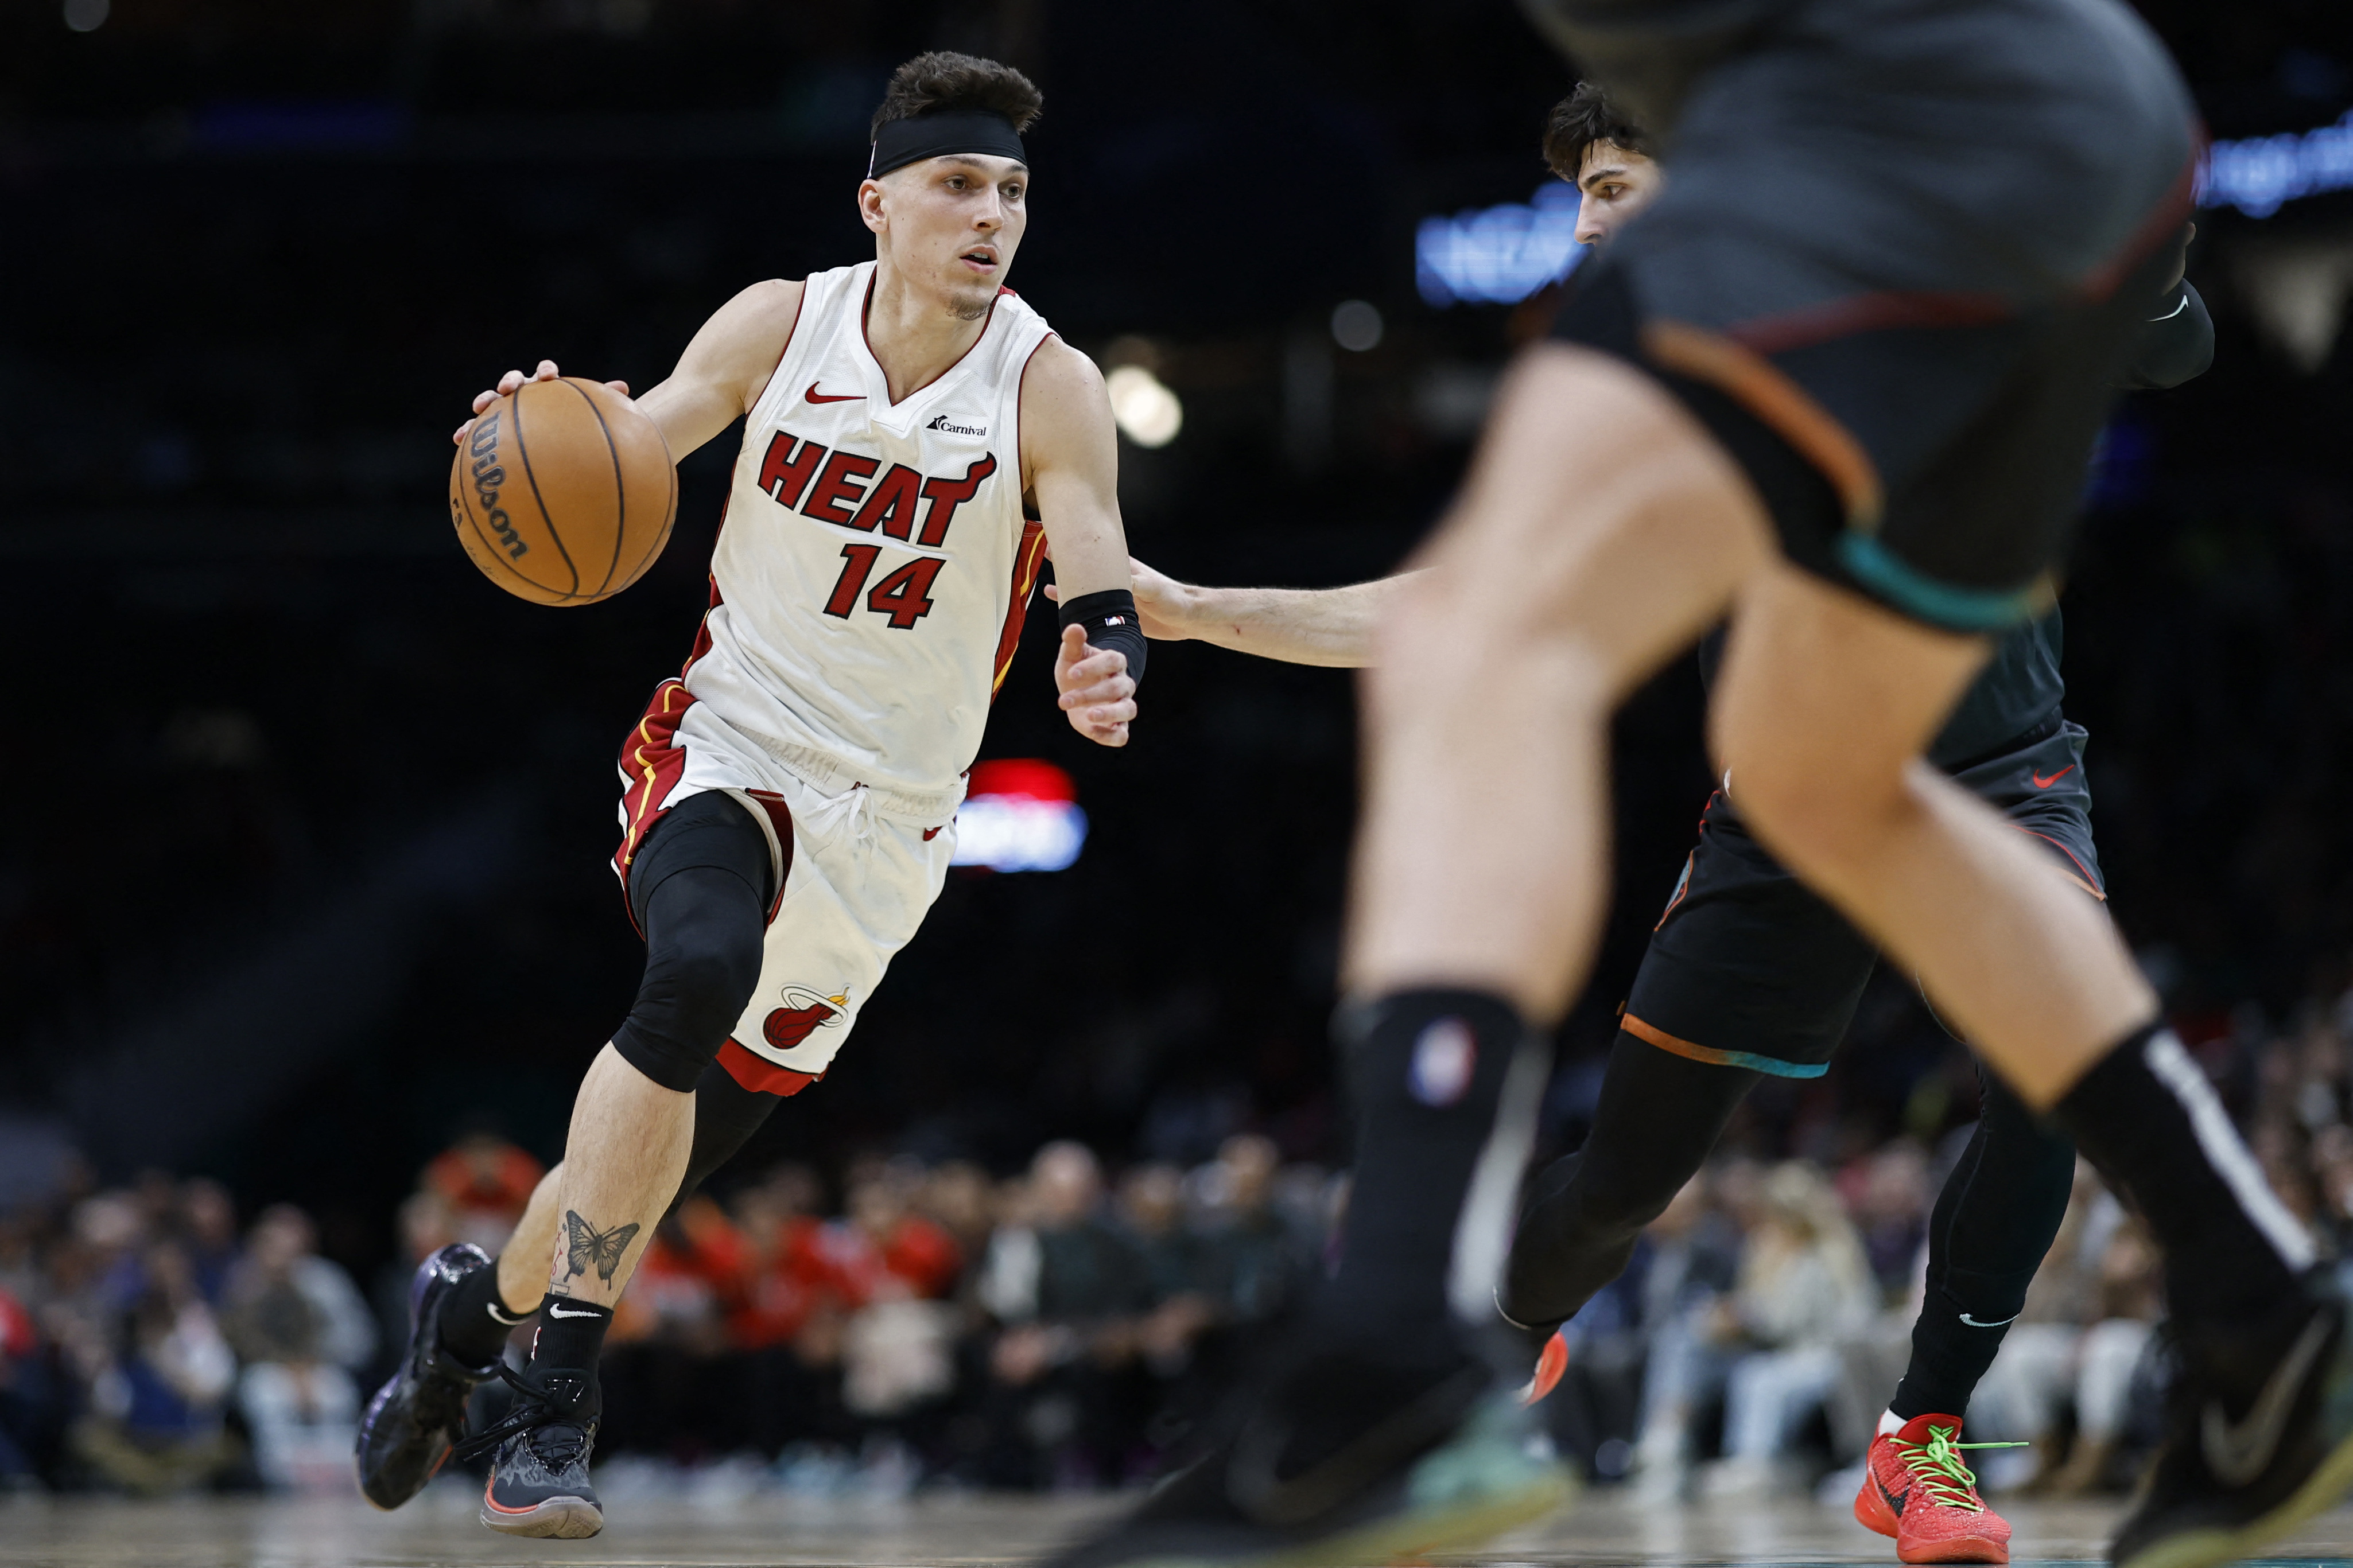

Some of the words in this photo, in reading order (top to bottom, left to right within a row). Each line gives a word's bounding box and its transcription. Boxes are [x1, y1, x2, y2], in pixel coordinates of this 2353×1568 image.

[940, 422, 987, 436] Carnival
[471, 410, 529, 561] Wilson
[758, 429, 997, 548] HEAT
[822, 543, 946, 630] 14
